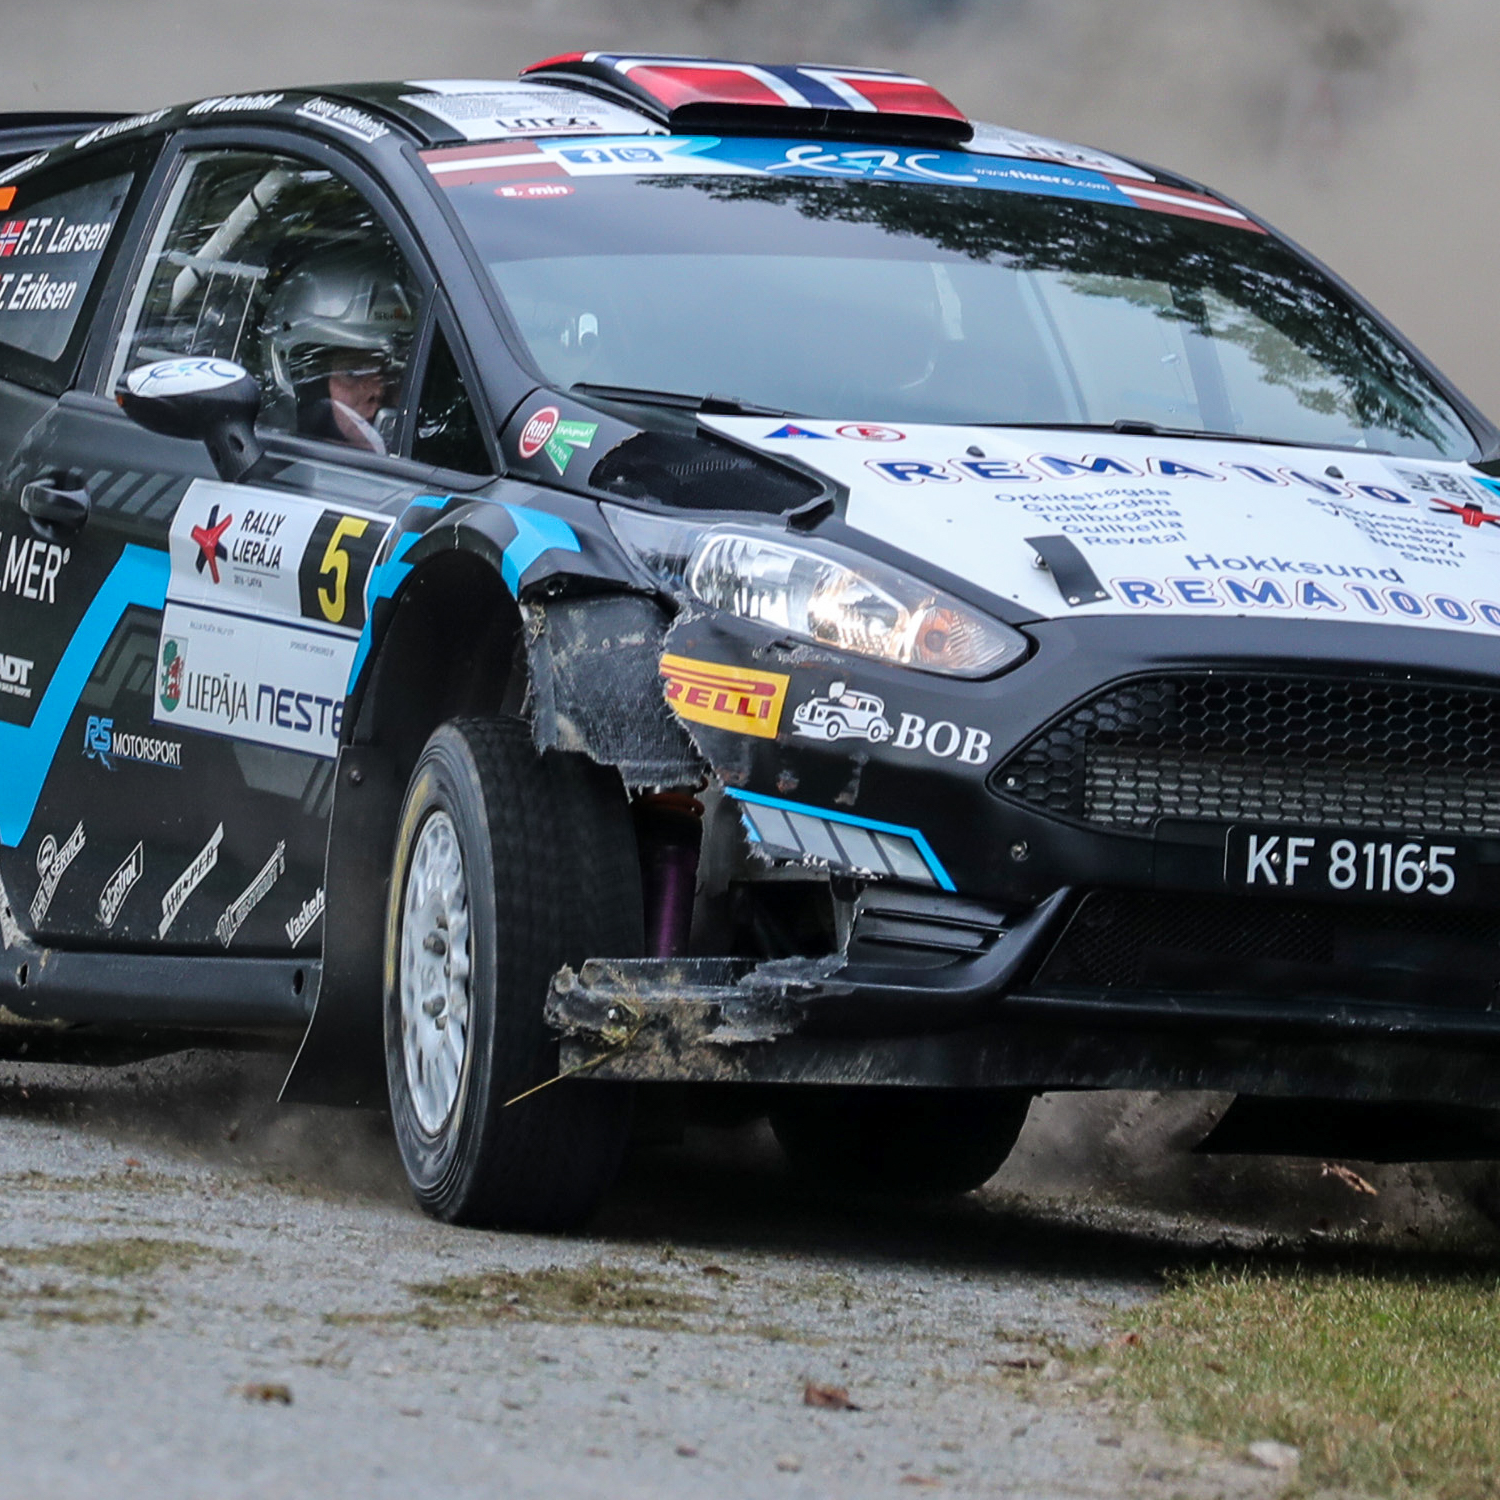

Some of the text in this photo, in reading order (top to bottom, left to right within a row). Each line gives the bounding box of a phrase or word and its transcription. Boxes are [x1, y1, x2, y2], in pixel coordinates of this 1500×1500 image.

[47, 217, 112, 253] Larsen
[11, 273, 78, 311] Eriksen
[240, 509, 286, 537] RALLY
[1083, 531, 1188, 546] Revetal
[232, 537, 283, 570] LIEPĀJA
[317, 515, 369, 623] 5
[1185, 553, 1405, 584] Hokksund
[186, 672, 249, 725] LIEPĀJA
[665, 681, 772, 720] RELLI
[113, 731, 182, 766] MOTORSPORT
[892, 712, 992, 765] BOB
[1246, 834, 1457, 895] KF 81165
